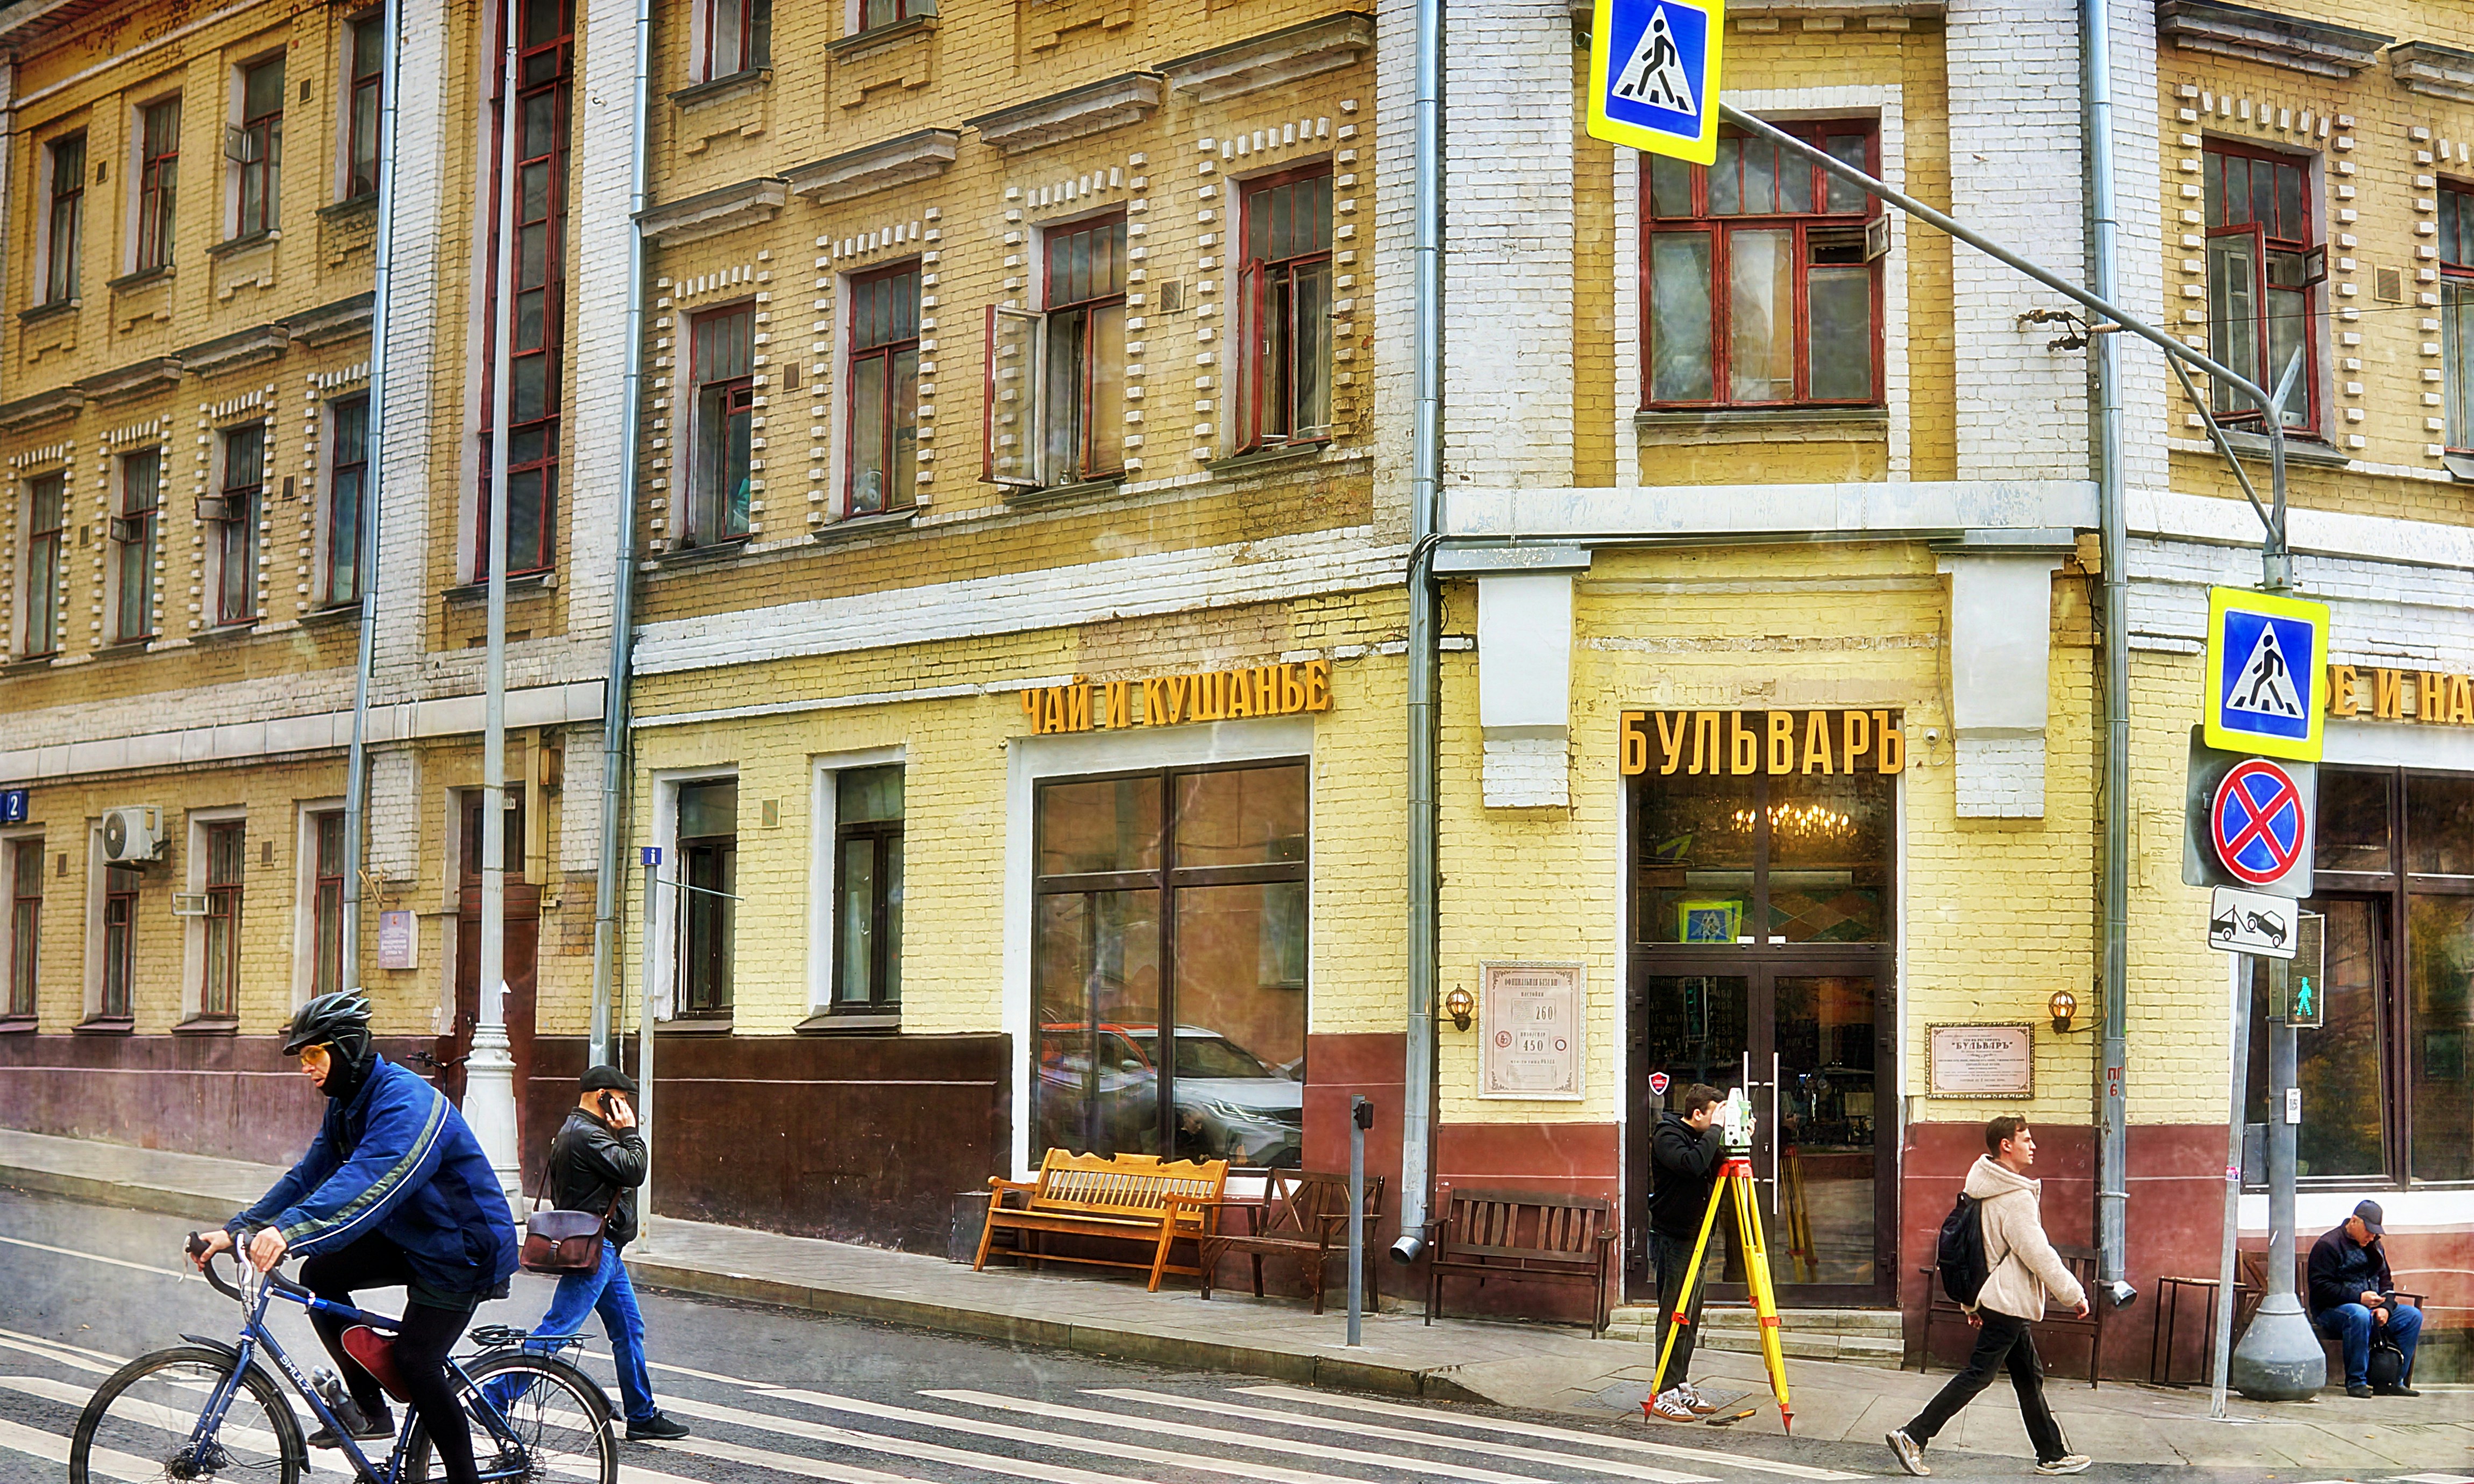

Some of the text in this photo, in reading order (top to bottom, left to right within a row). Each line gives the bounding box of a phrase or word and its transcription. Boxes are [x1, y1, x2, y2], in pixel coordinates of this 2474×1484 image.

[1021, 660, 1333, 734] ЧАЙ И КУШАНЬЕ
[2372, 668, 2404, 719] И
[2416, 672, 2474, 724] НА
[1620, 710, 1904, 776] БУЛЬВАРЪ
[10, 795, 18, 816] 2
[650, 848, 656, 864] i
[1536, 1006, 1553, 1021] 260
[1523, 1040, 1544, 1052] 450
[2107, 1066, 2123, 1081] ПГ
[2109, 1083, 2118, 1097] 6
[279, 1354, 312, 1394] SHULZ
